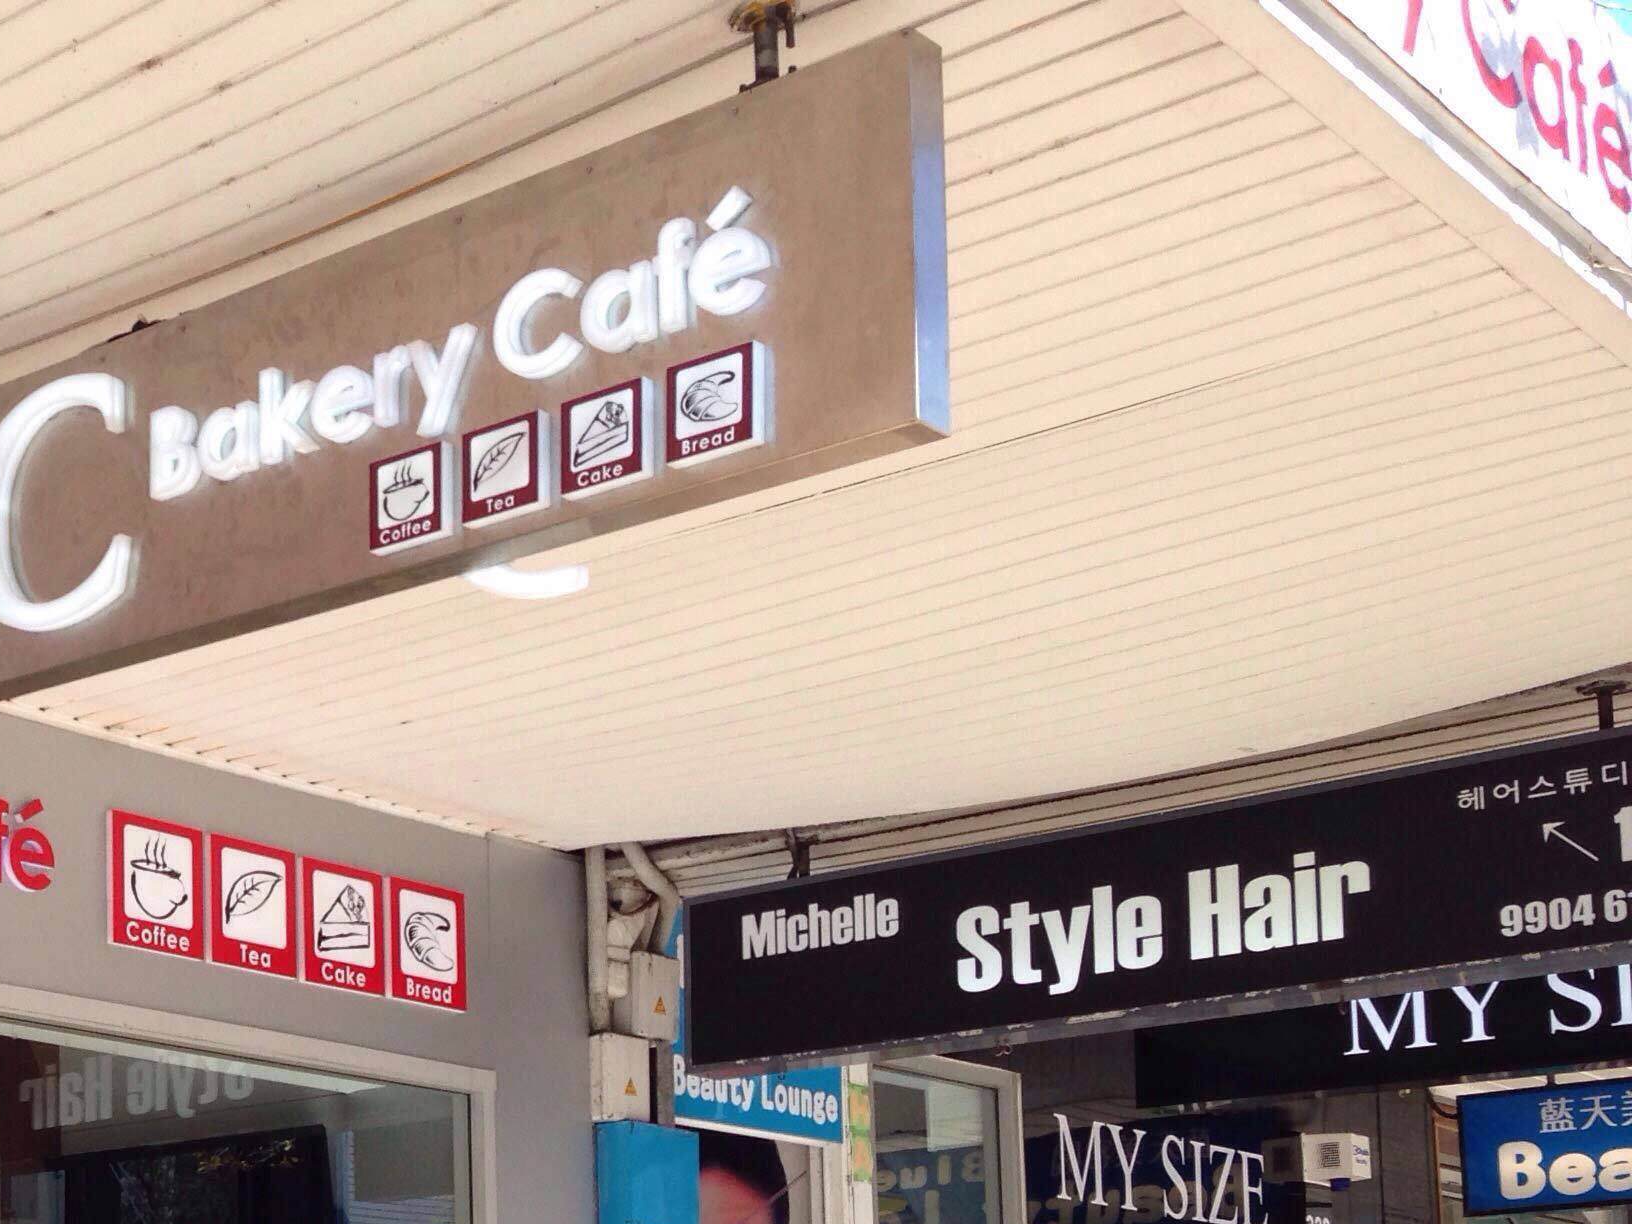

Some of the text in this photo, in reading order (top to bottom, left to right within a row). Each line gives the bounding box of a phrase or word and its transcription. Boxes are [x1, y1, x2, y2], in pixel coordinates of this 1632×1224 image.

[149, 322, 478, 500] Bakery
[493, 186, 773, 380] Café
[378, 426, 736, 545] Coffee Tea Cake Bread
[741, 851, 1370, 996] Michelle Style Hair
[1500, 888, 1632, 938] 9904 6
[125, 920, 453, 1005] Coffee Tea Cake Bread
[1343, 980, 1503, 1057] MY
[673, 1054, 839, 1126] Beauty Lounge
[1053, 1113, 1147, 1212] MY
